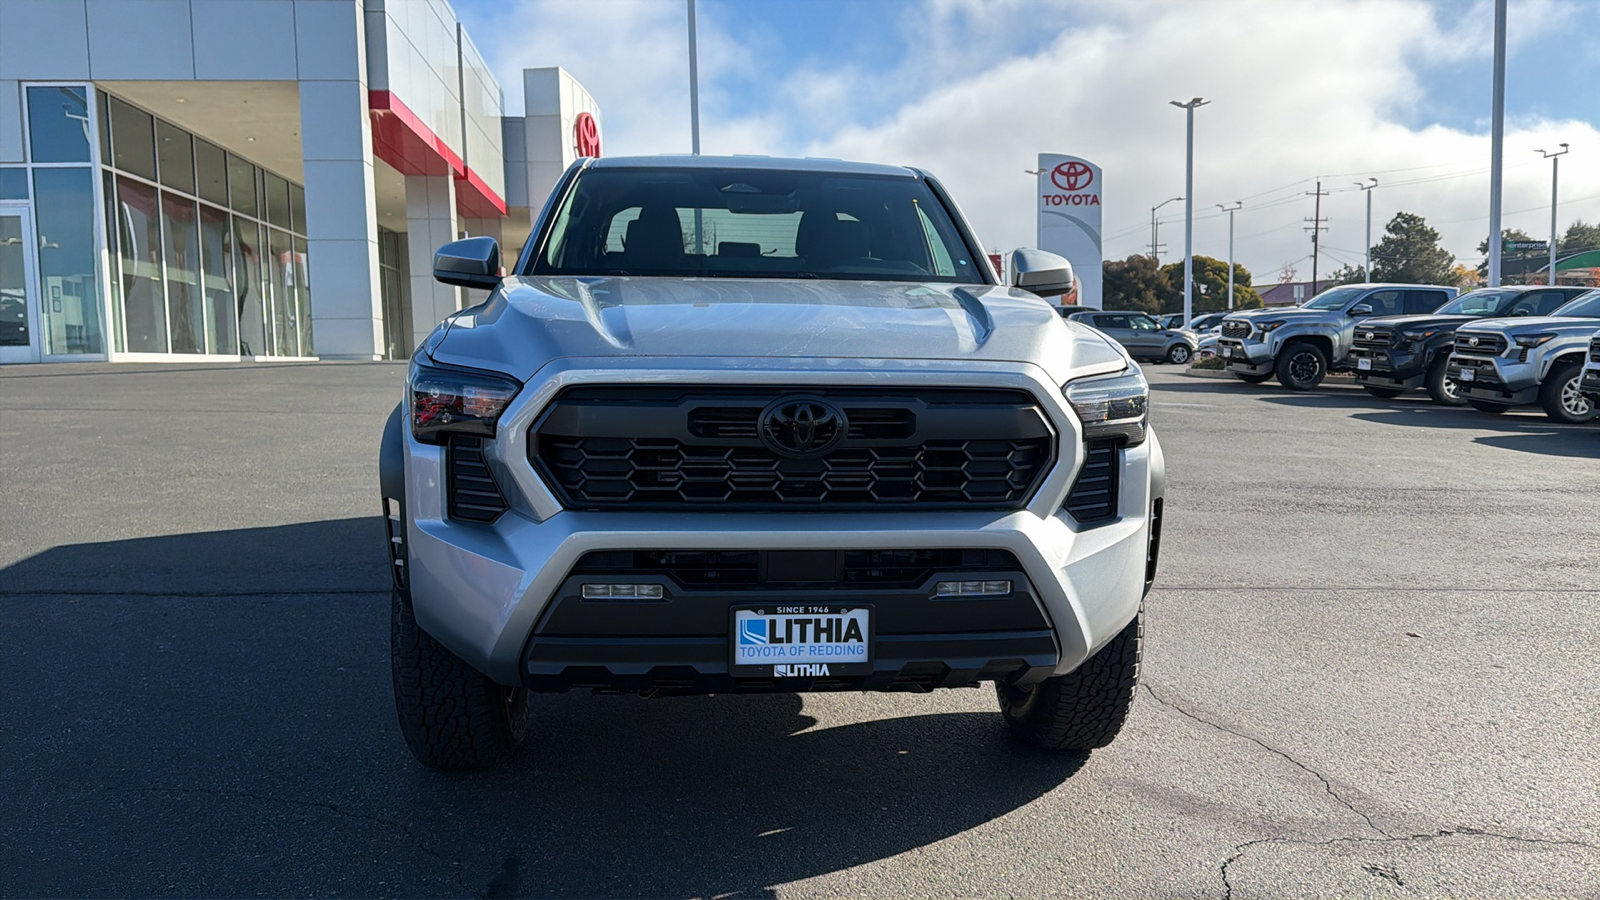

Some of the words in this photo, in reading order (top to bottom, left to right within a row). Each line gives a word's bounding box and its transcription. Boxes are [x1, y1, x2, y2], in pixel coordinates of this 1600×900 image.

[1042, 194, 1100, 206] TOYOTA
[776, 606, 805, 614] SINCE
[769, 618, 864, 644] LITHIA
[740, 646, 786, 657] TOYOTA
[789, 646, 805, 656] OF
[809, 645, 865, 656] REDDING
[786, 663, 830, 677] LITHIA
